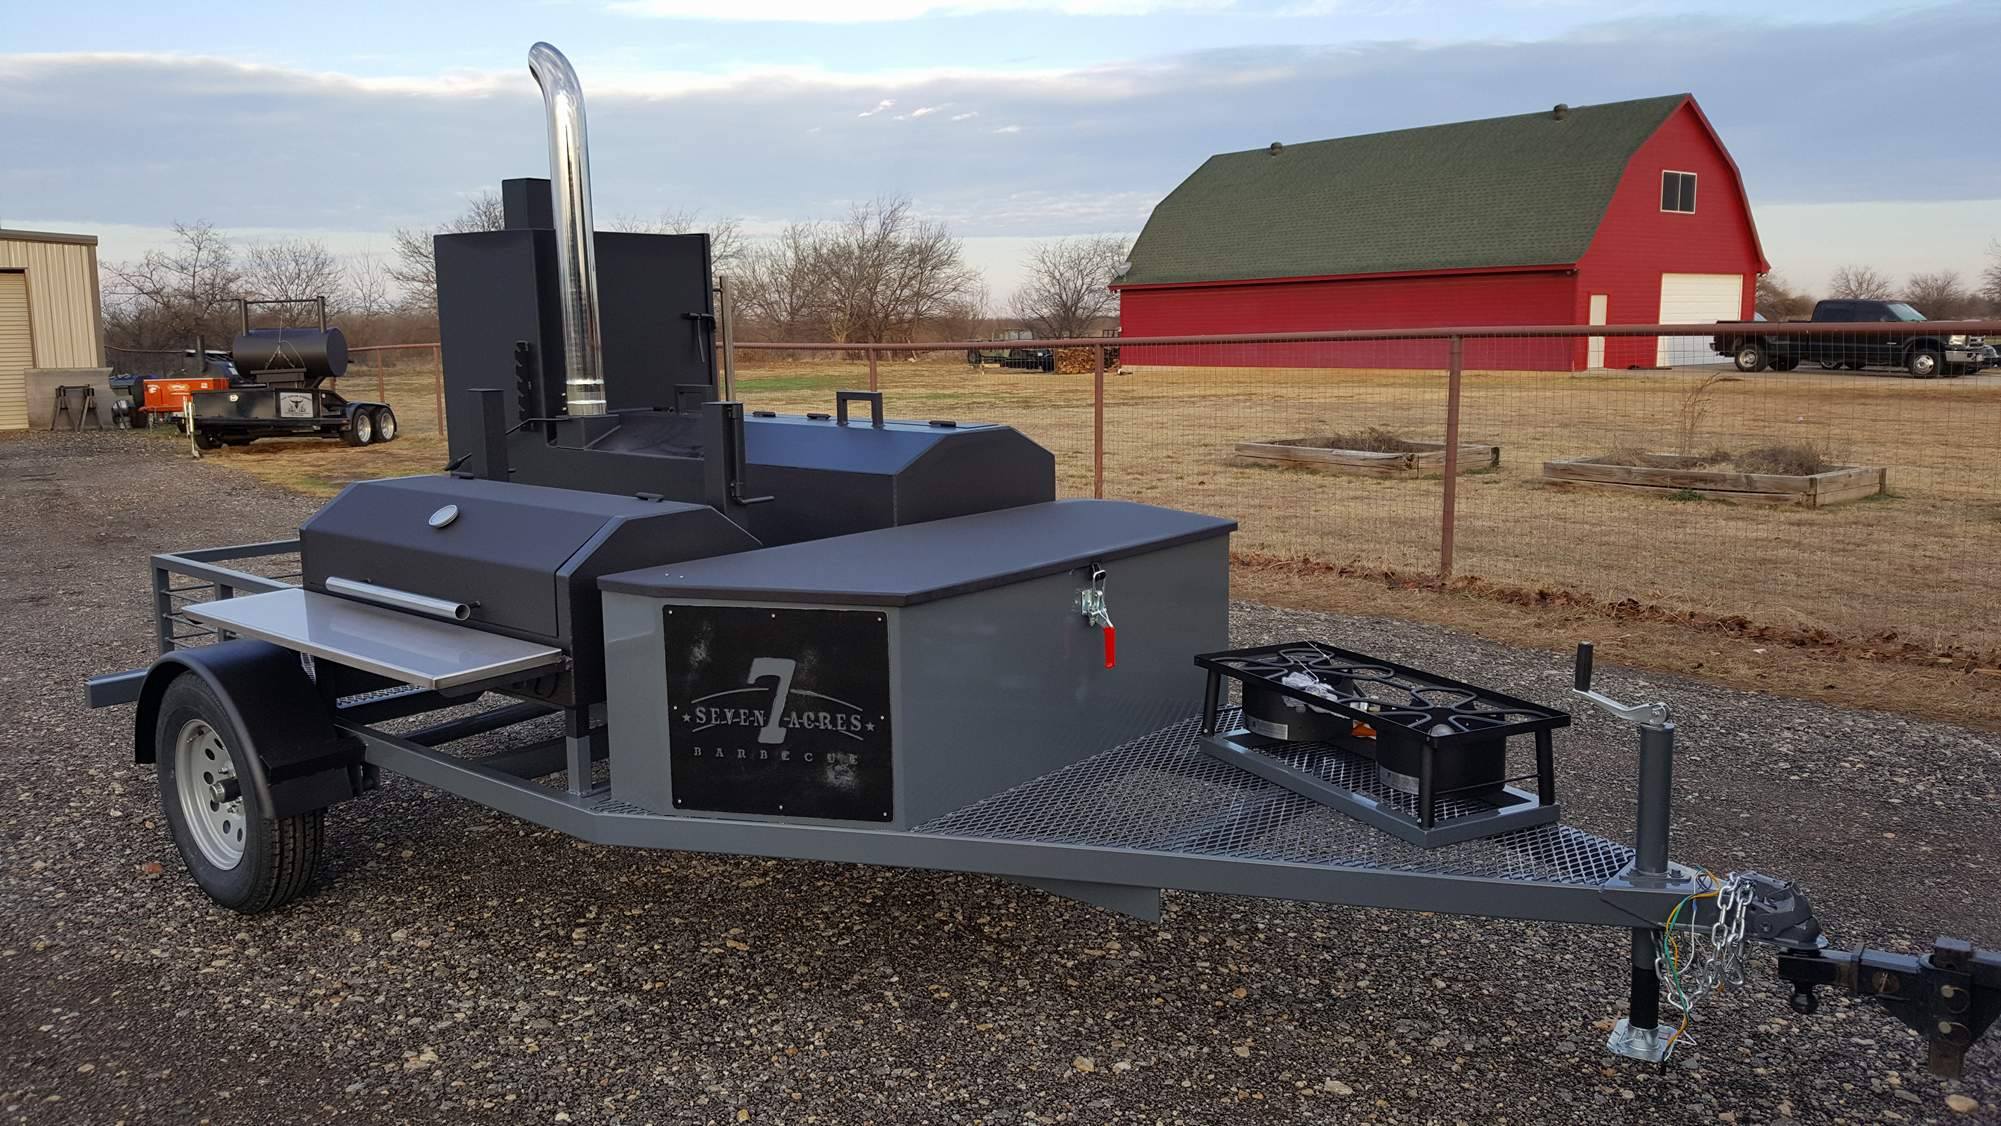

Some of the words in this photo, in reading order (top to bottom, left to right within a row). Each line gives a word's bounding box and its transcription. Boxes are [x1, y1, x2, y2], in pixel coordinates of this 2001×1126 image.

[747, 657, 797, 744] 7
[695, 706, 766, 727] SEVEN
[788, 711, 863, 732] ACRES
[693, 746, 859, 765] BARBECUE
